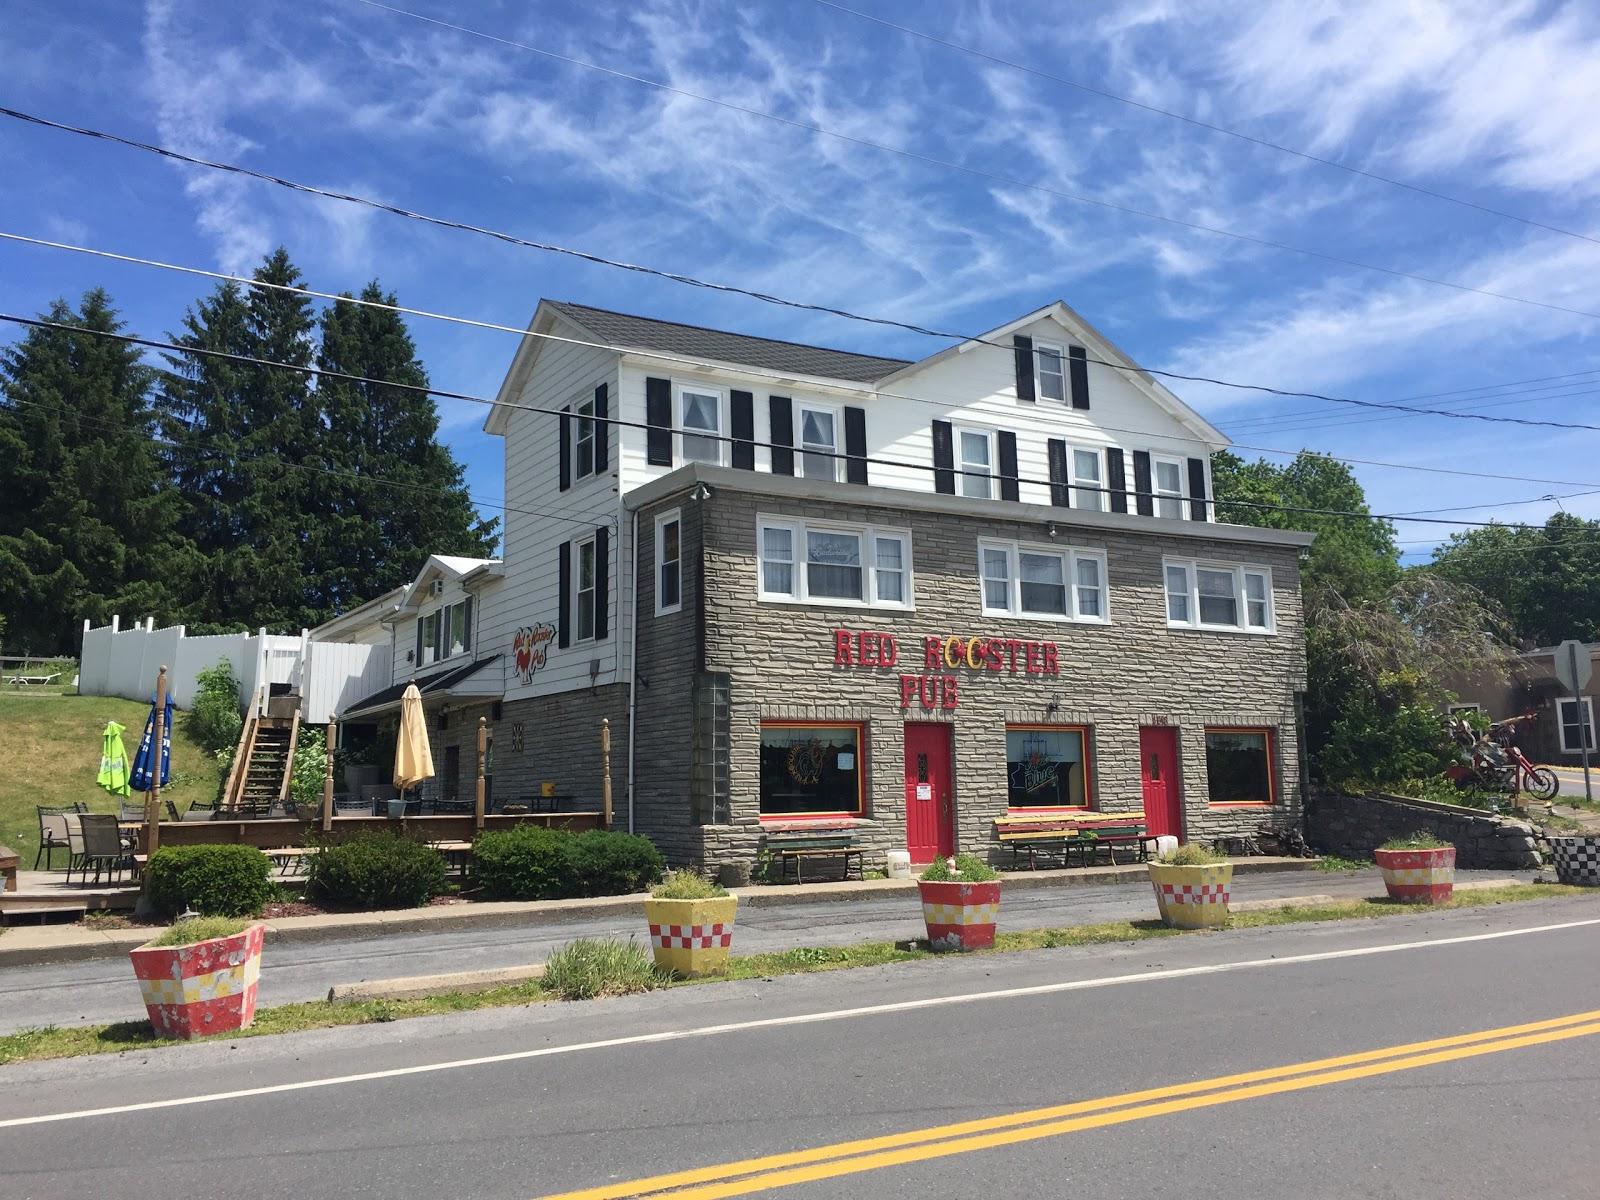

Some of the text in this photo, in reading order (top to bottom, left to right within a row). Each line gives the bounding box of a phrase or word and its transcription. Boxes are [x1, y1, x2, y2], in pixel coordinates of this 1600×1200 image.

[834, 629, 1060, 674] RED ROOSTER
[900, 674, 960, 710] PUB
